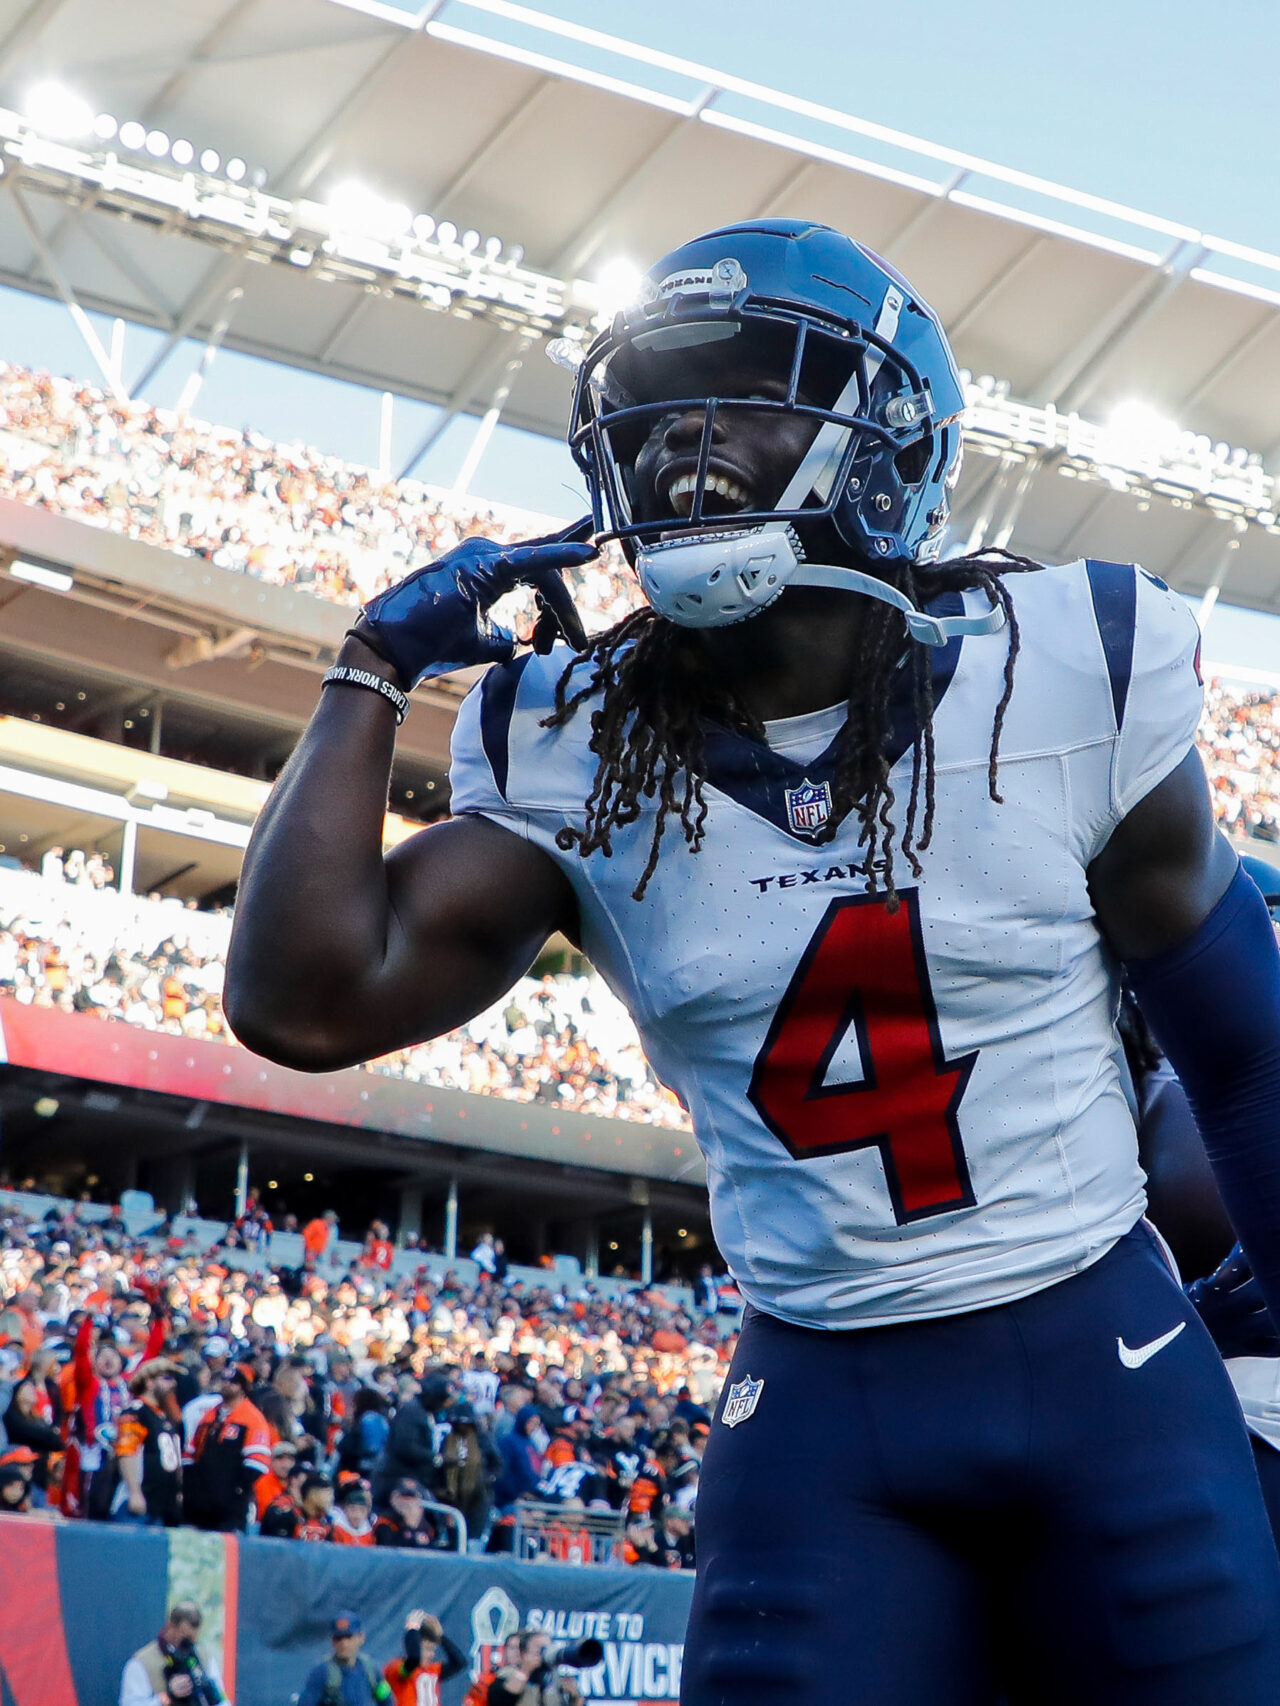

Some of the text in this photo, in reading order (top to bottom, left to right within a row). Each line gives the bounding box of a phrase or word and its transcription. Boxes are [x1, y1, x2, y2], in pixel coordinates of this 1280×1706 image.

[346, 667, 380, 690] WORK
[380, 681, 406, 709] CARES
[794, 801, 827, 827] NFL
[747, 886, 980, 1226] 4
[728, 1398, 751, 1418] NFL
[526, 1608, 644, 1641] SALUTE TO
